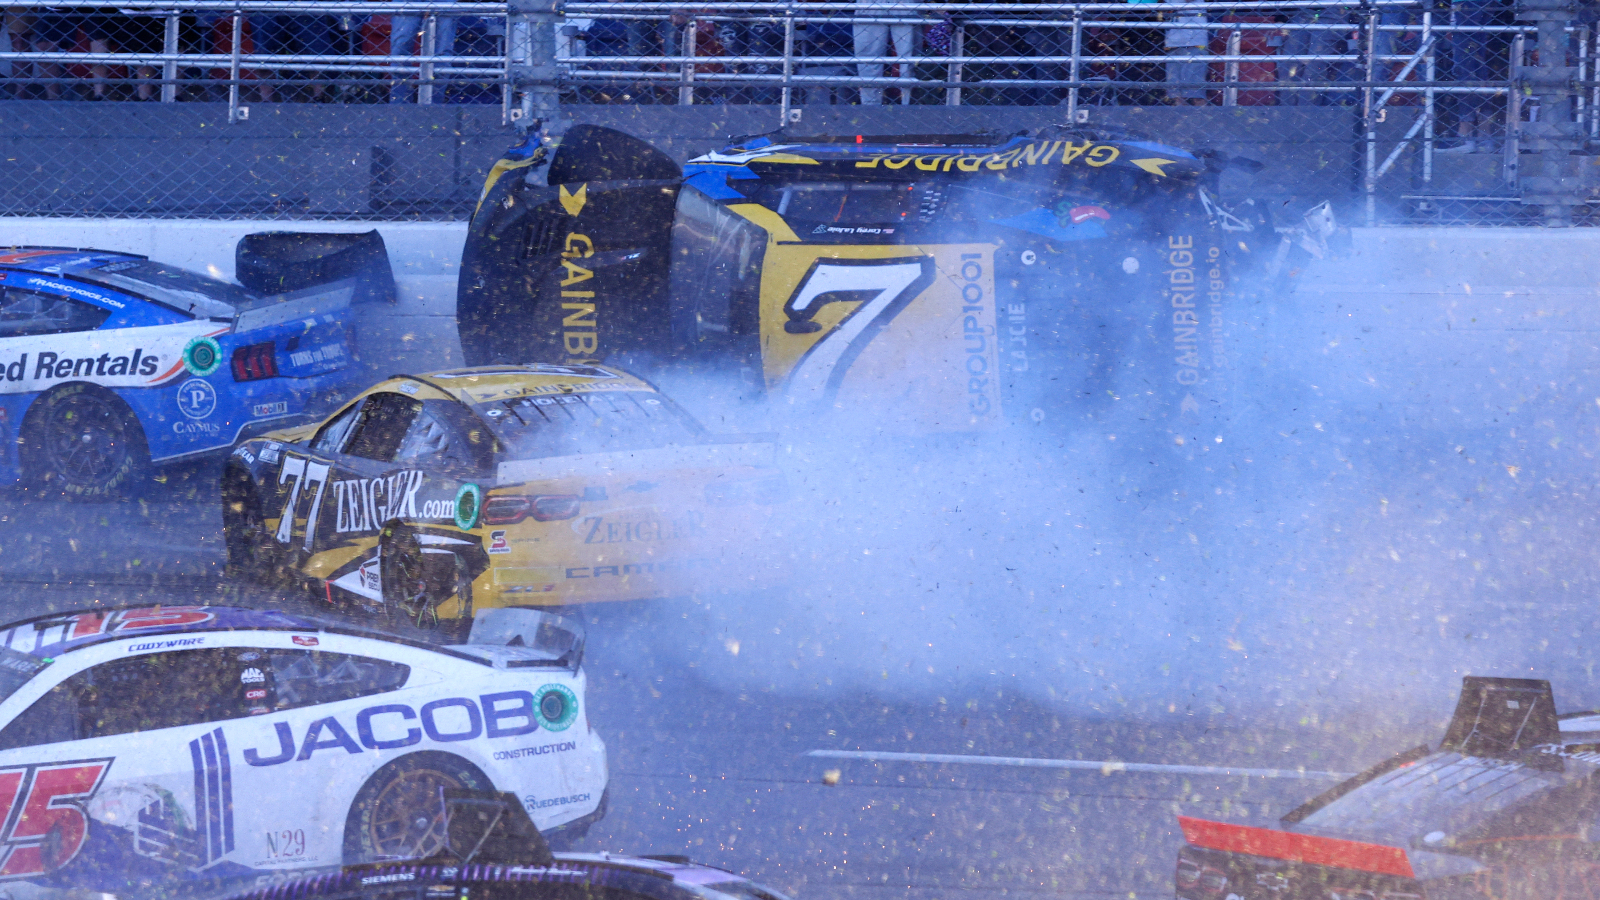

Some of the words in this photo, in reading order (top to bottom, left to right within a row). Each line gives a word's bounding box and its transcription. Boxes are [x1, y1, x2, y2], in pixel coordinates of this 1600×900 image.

[855, 140, 1120, 172] GAINBRIDGE
[561, 231, 598, 365] GAINB
[1169, 234, 1199, 386] GAINBRIDGE
[1205, 246, 1229, 369] gainbridge.io
[786, 257, 934, 406] 7
[960, 252, 991, 417] GROUP1001
[0, 353, 27, 381] d
[34, 348, 159, 380] Rentals
[190, 390, 205, 409] P
[172, 421, 220, 434] CAYMUS
[277, 454, 331, 552] 77
[584, 510, 706, 545] ZEIGLER
[66, 605, 215, 642] 15
[128, 640, 165, 652] CODY
[166, 636, 205, 649] WARE
[243, 690, 541, 767] JACOB
[493, 740, 577, 760] CONSTRUCTION
[526, 793, 591, 811] RUEDEBUSCH
[361, 872, 415, 885] SIEMENS
